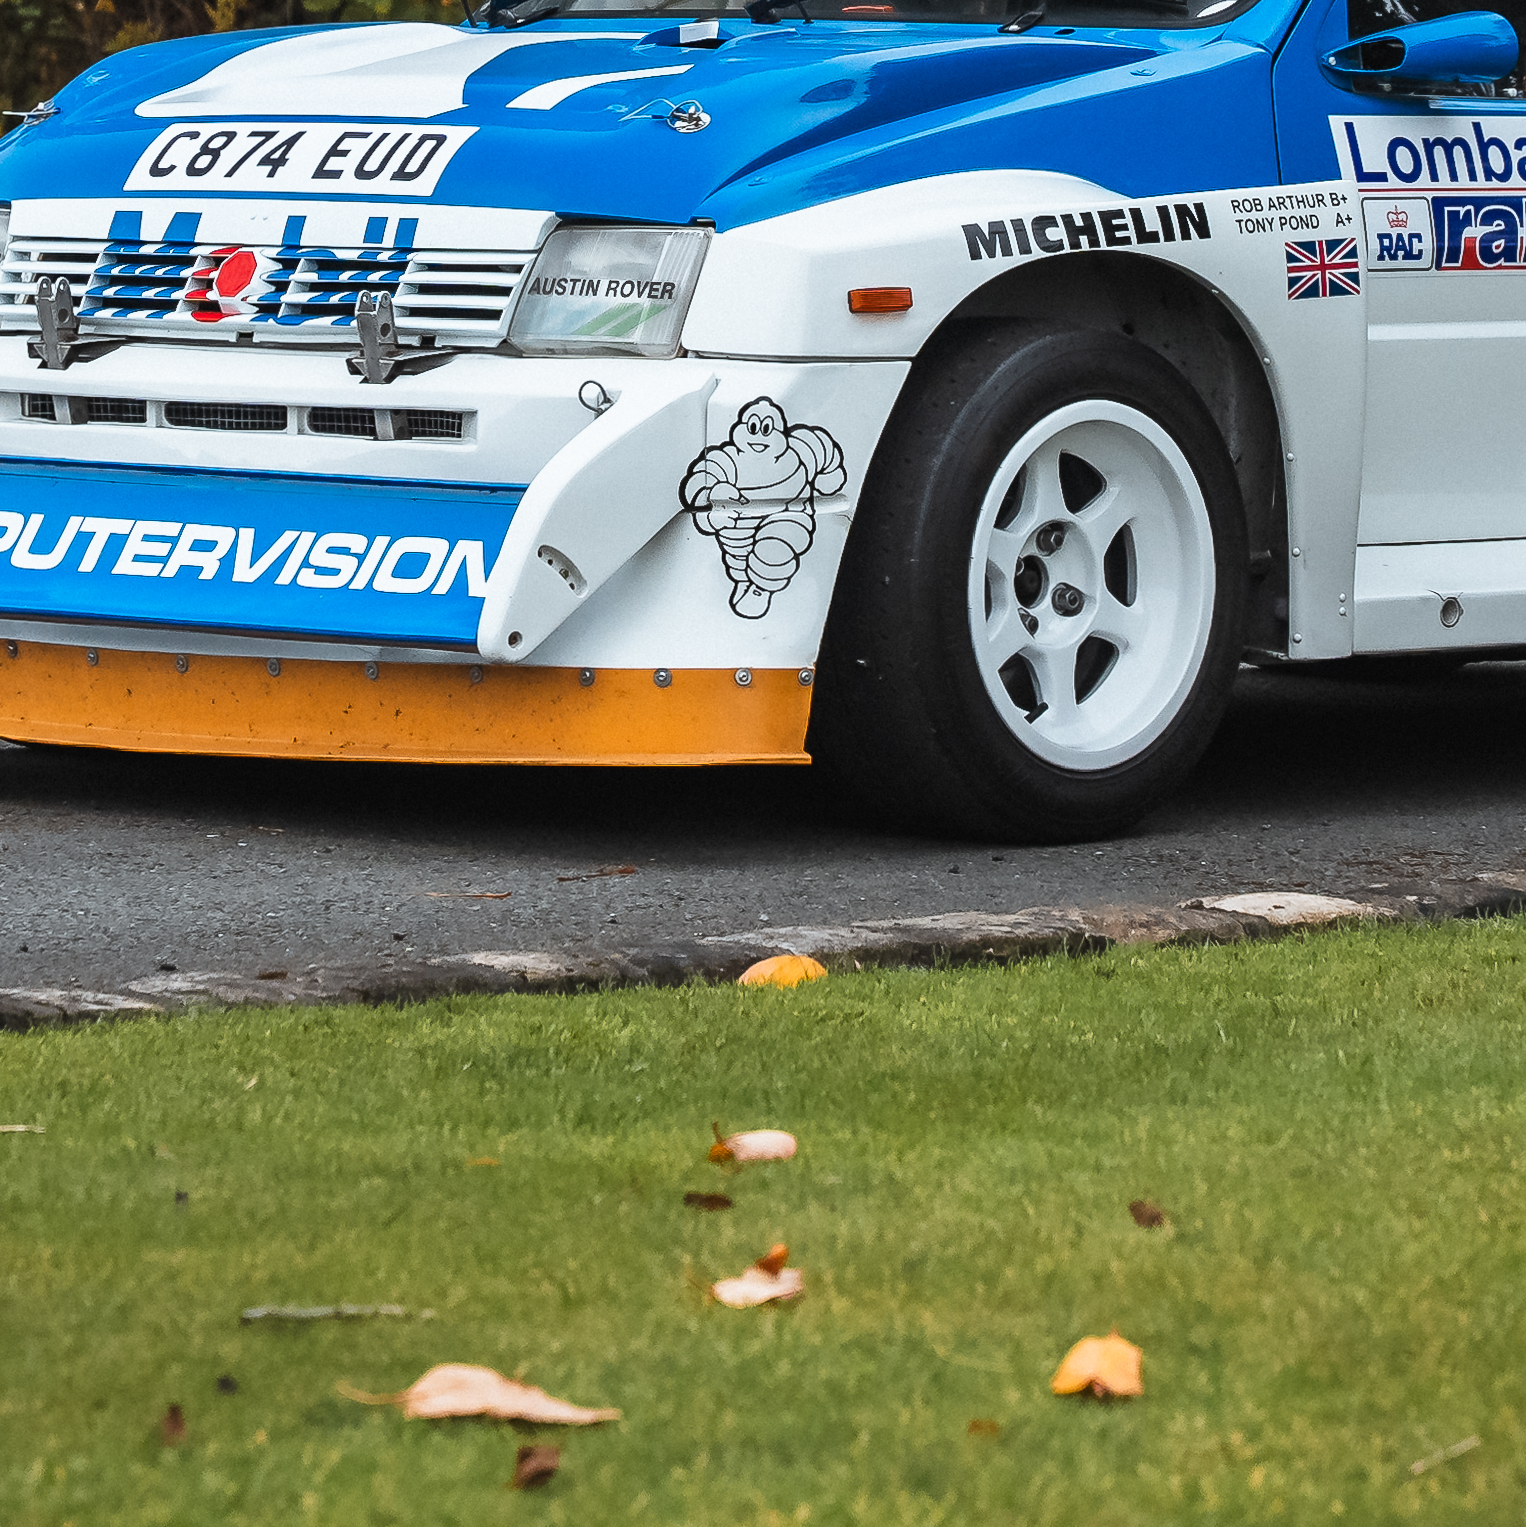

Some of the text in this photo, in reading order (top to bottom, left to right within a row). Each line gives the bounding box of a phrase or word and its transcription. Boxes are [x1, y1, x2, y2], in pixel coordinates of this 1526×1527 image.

[149, 130, 448, 182] C874 EUD
[1230, 192, 1348, 214] ROB ARTHUR B+
[961, 202, 1212, 261] MICHELIN
[1235, 212, 1353, 234] TONY POND A+
[1376, 232, 1423, 262] RAC
[527, 277, 676, 300] AUSTIN ROVER
